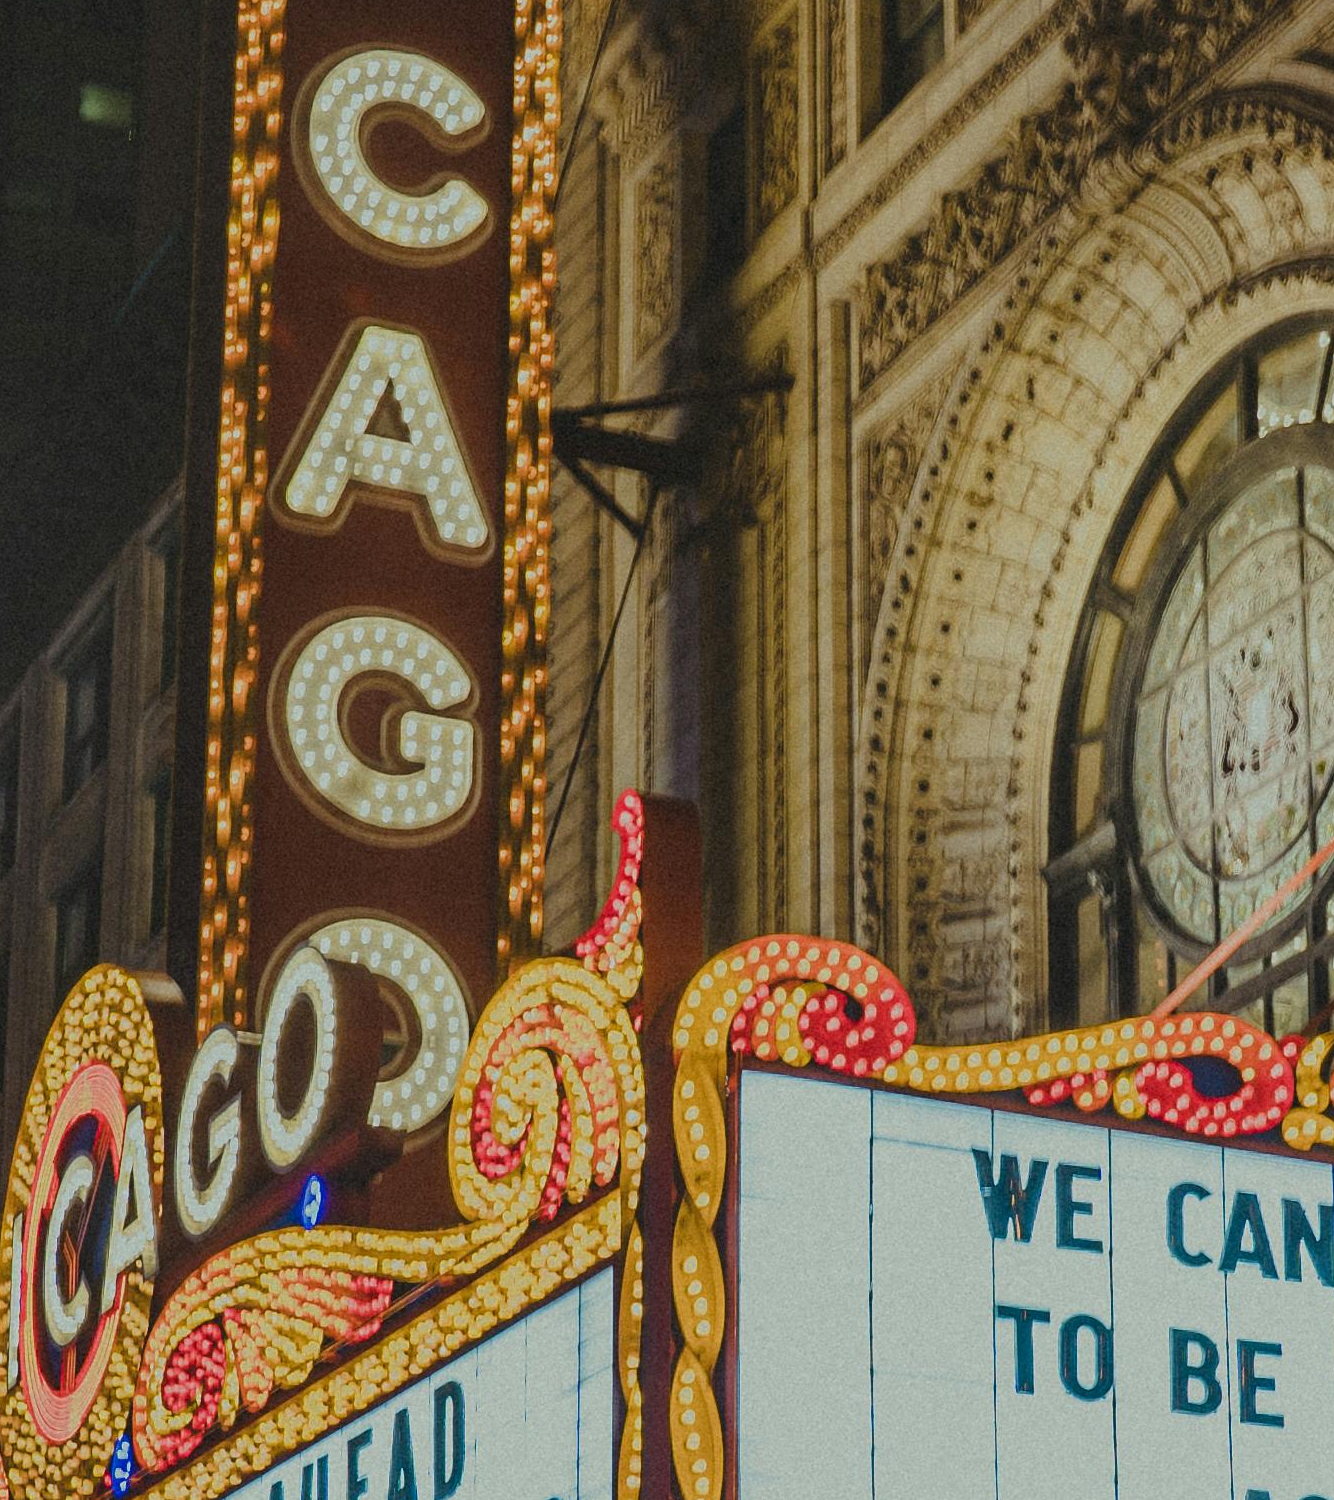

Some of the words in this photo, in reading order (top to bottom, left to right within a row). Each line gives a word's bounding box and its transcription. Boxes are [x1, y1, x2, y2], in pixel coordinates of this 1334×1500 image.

[972, 1148, 1104, 1254] WE
[993, 1303, 1114, 1403] TO
[1169, 1327, 1285, 1429] BE
